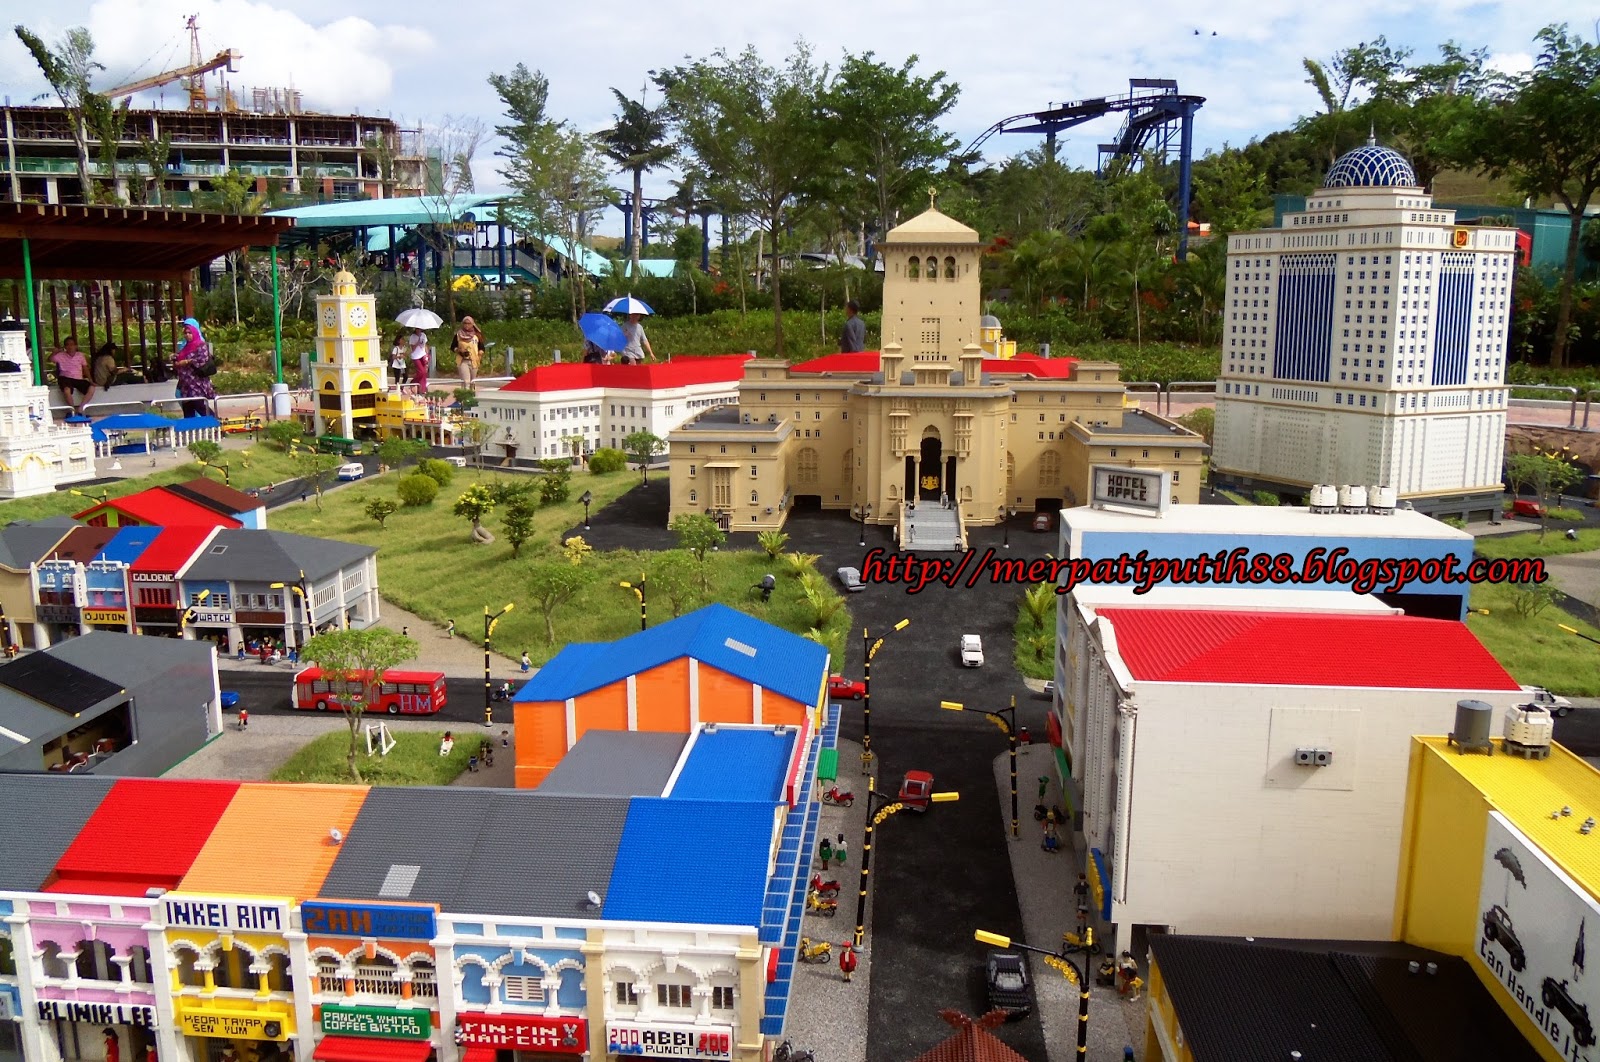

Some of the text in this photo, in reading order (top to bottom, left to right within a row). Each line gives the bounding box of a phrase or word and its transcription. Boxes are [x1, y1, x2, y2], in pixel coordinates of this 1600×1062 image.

[1107, 475, 1147, 490] HOTEL
[1107, 486, 1147, 501] APPLE
[199, 613, 231, 622] WATCH
[236, 905, 281, 930] RIM
[1481, 936, 1504, 978] Can
[1507, 969, 1560, 1042] Handle
[38, 1001, 153, 1026] KLINIK LEE
[376, 1015, 416, 1026] WHITE
[192, 1024, 248, 1035] SEN YUM
[324, 1020, 421, 1035] COFFEE BISTRO
[609, 1028, 639, 1045] 200
[642, 1030, 694, 1047] ABBI
[698, 1032, 730, 1052] 200
